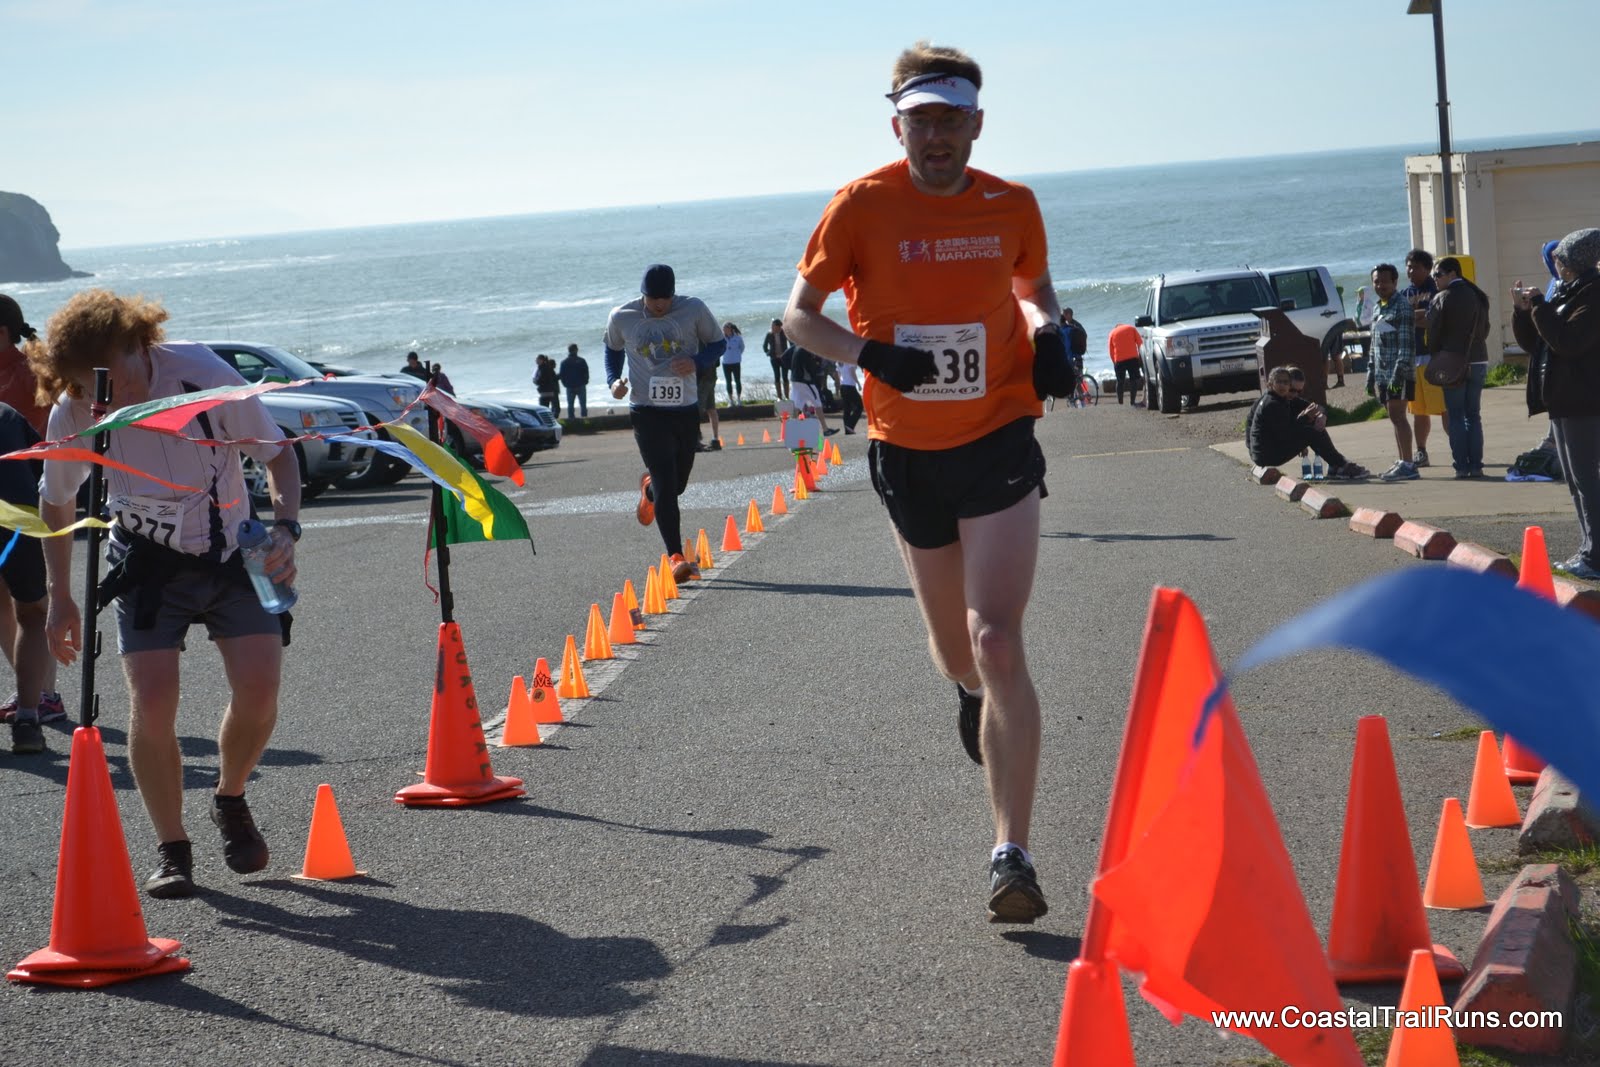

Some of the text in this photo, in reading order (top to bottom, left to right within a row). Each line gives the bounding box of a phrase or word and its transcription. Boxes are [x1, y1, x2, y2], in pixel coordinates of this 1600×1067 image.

[935, 249, 1002, 262] MARATHON
[651, 385, 681, 400] 1393
[911, 387, 957, 395] ALOMON
[115, 510, 176, 547] 1277
[451, 629, 490, 777] COASTAL
